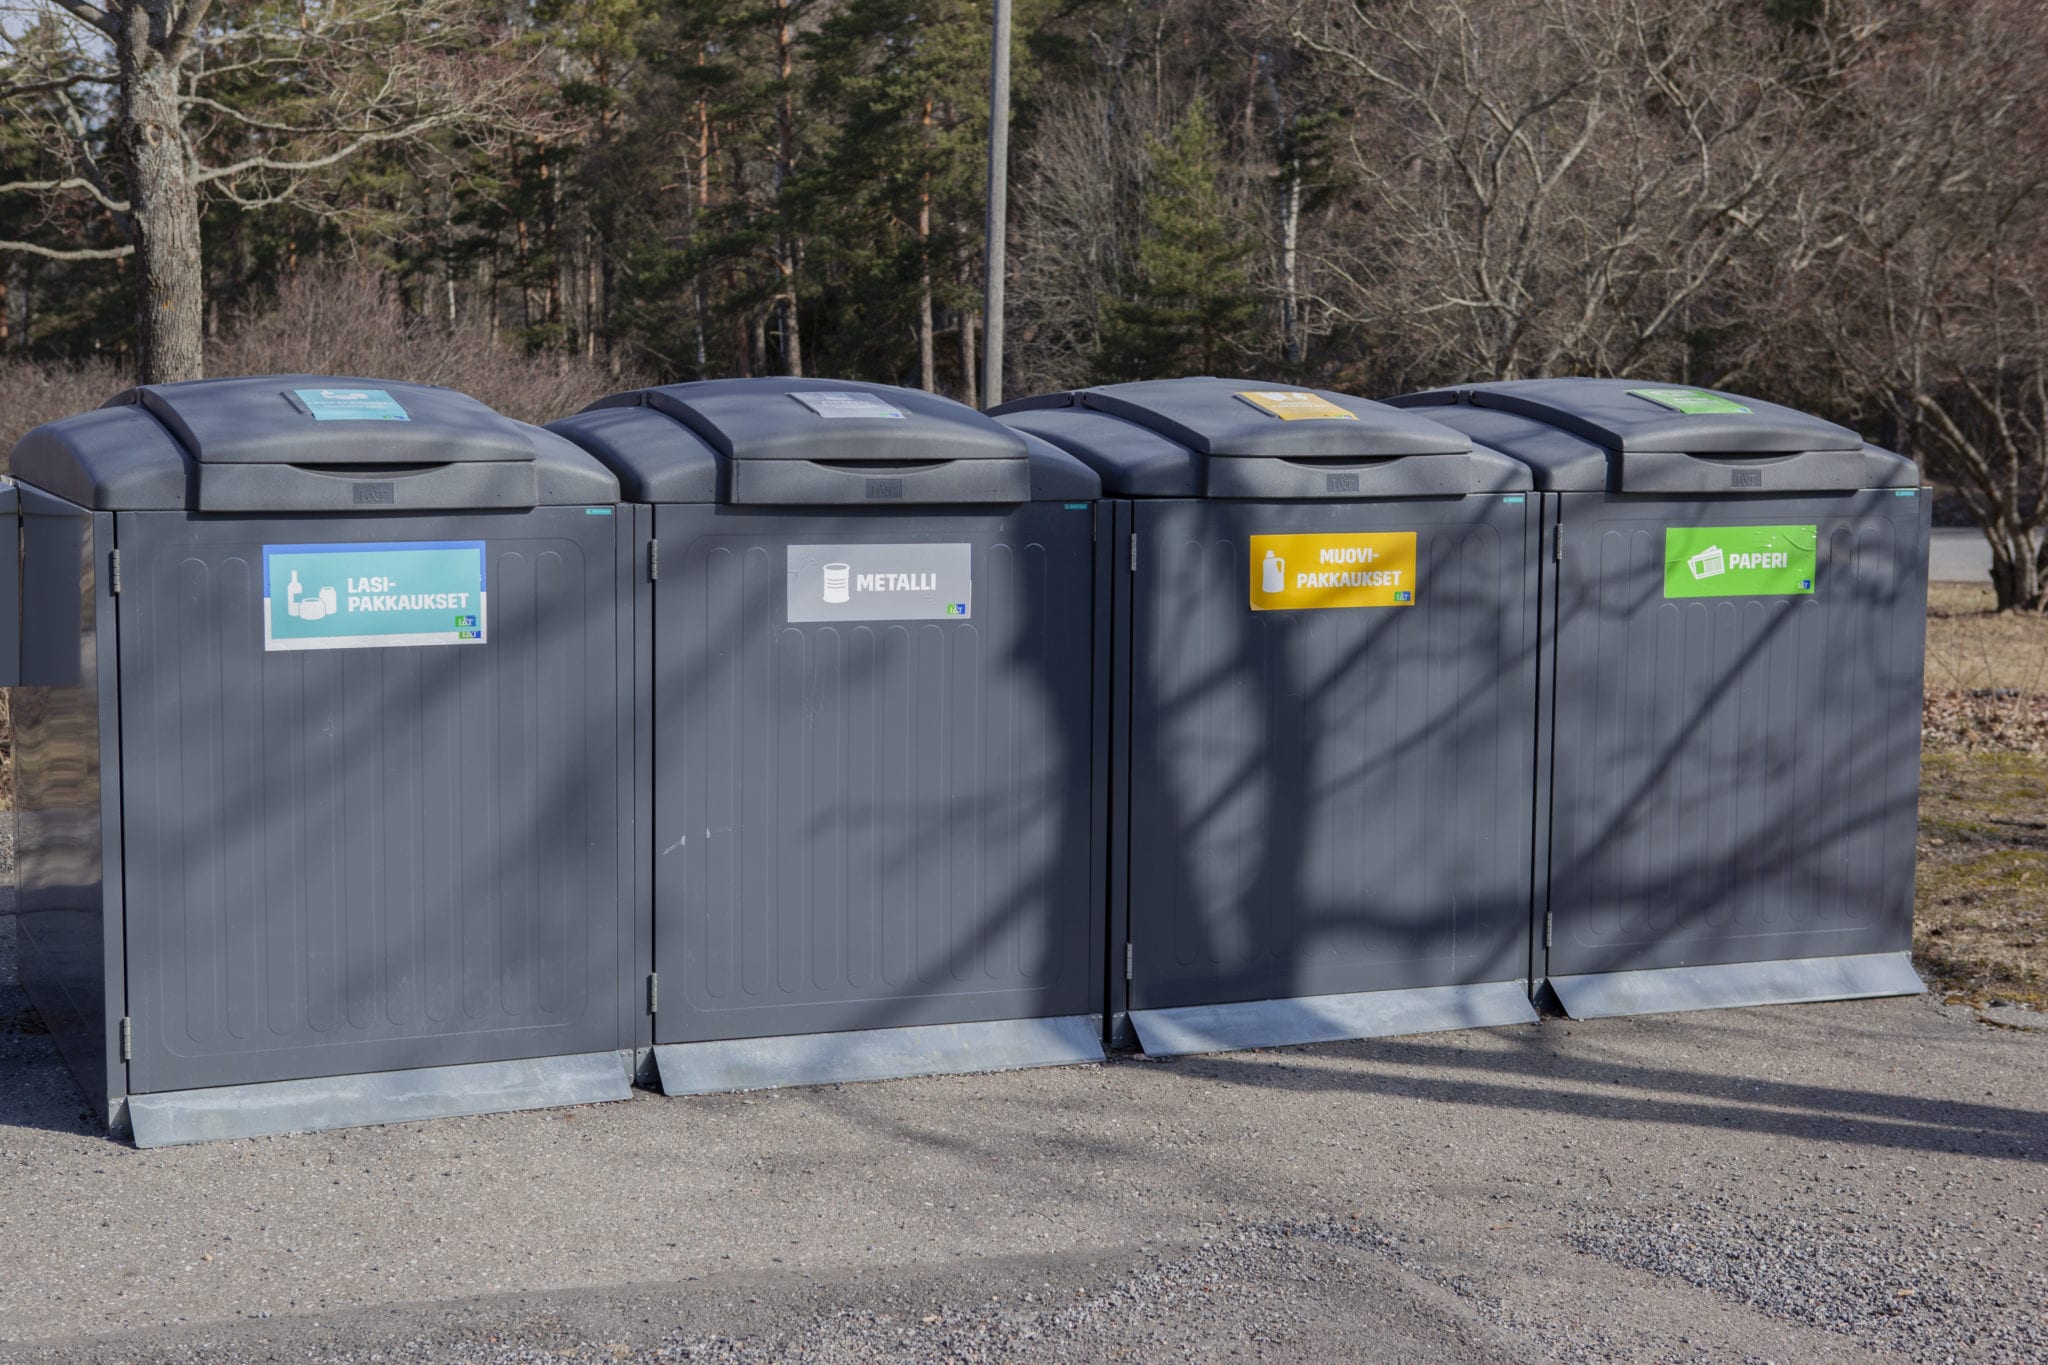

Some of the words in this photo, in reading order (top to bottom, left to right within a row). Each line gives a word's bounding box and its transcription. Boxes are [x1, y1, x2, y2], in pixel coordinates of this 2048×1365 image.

[1319, 548, 1379, 565] MUOVI-
[1729, 552, 1788, 569] PAPERI
[347, 576, 396, 593] LASI-
[856, 573, 937, 592] METALLI
[1297, 570, 1402, 588] PAKKAUKSET
[347, 593, 469, 613] PAKKAUKSET
